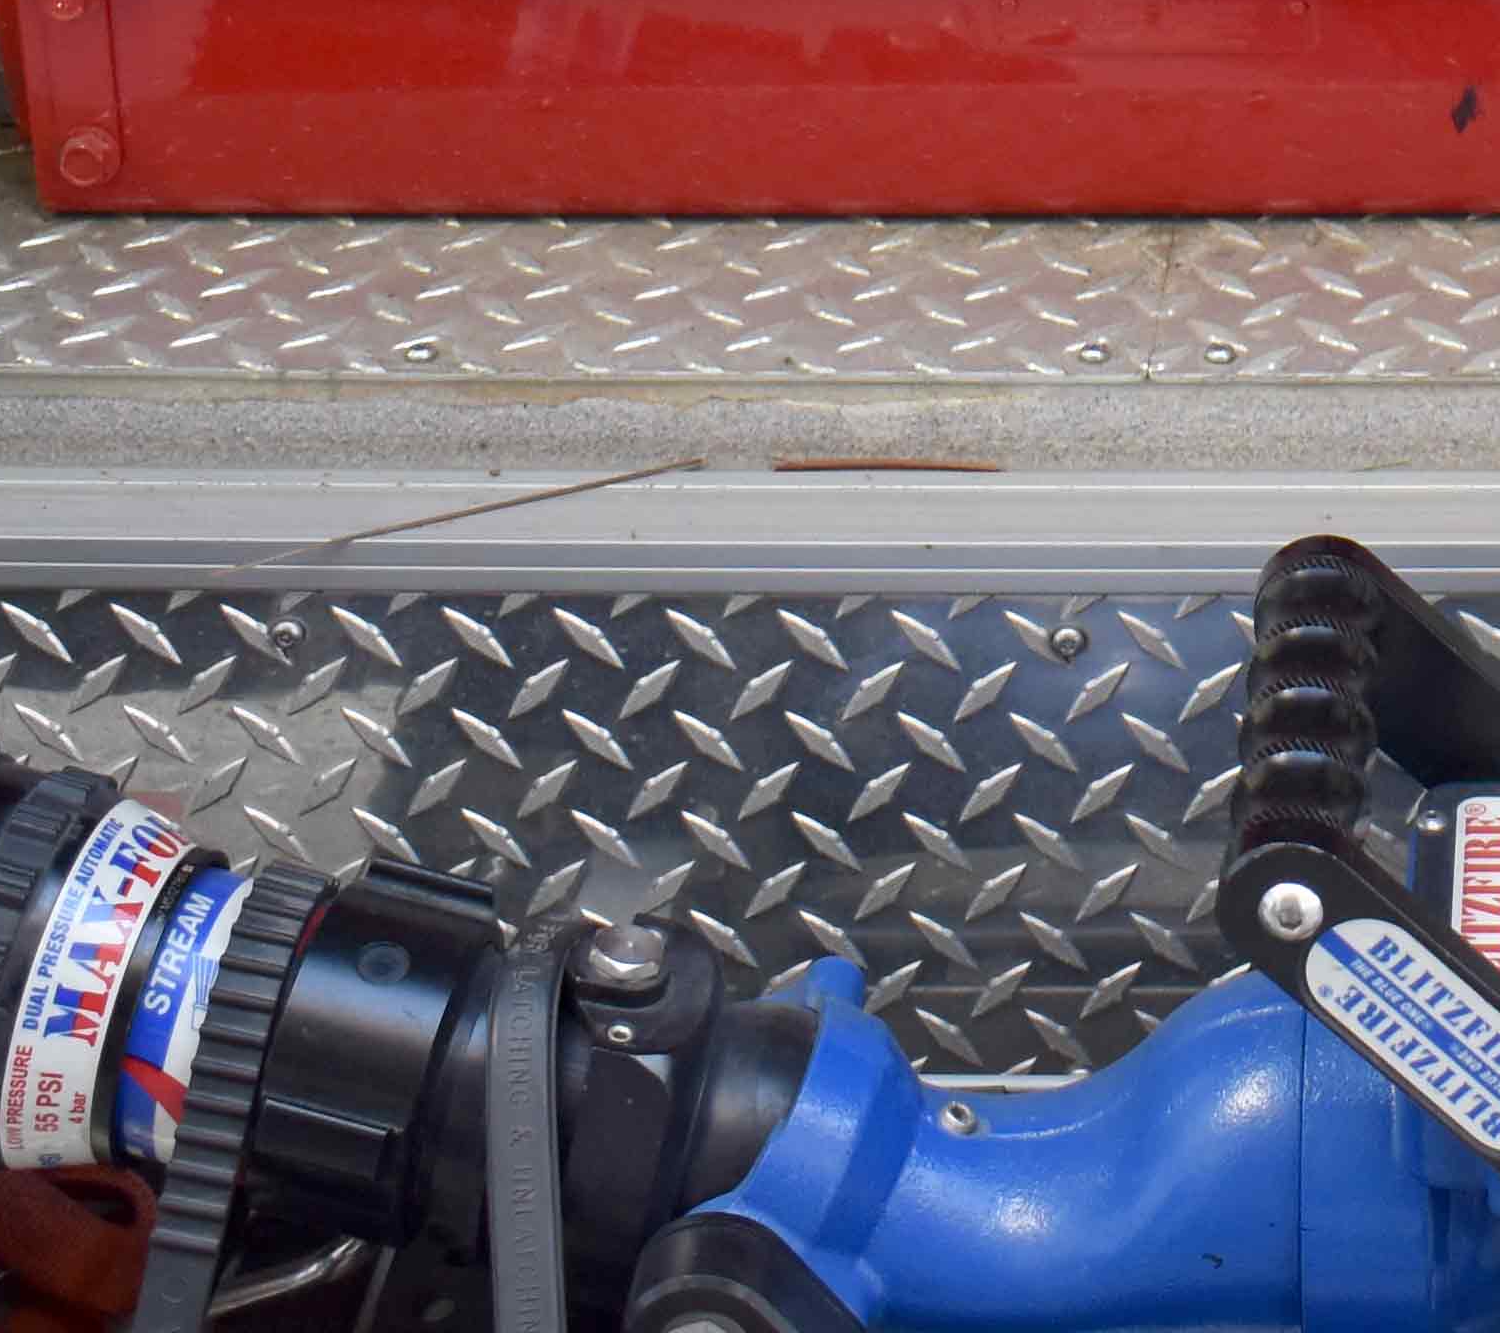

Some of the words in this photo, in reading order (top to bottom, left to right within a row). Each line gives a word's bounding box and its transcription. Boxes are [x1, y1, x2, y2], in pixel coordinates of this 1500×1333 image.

[22, 983, 50, 1031] DUAL
[37, 887, 83, 980] PRESSURE
[74, 817, 125, 892] AUTOMATIC
[143, 892, 216, 1016] STREAM
[507, 963, 541, 1111] LATCHING
[6, 1044, 34, 1126] PRESSURE
[35, 1071, 64, 1109] PSI
[68, 1091, 88, 1114] bar
[5, 1126, 24, 1151] LOW
[34, 1109, 60, 1133] 55
[69, 1115, 84, 1125] 4
